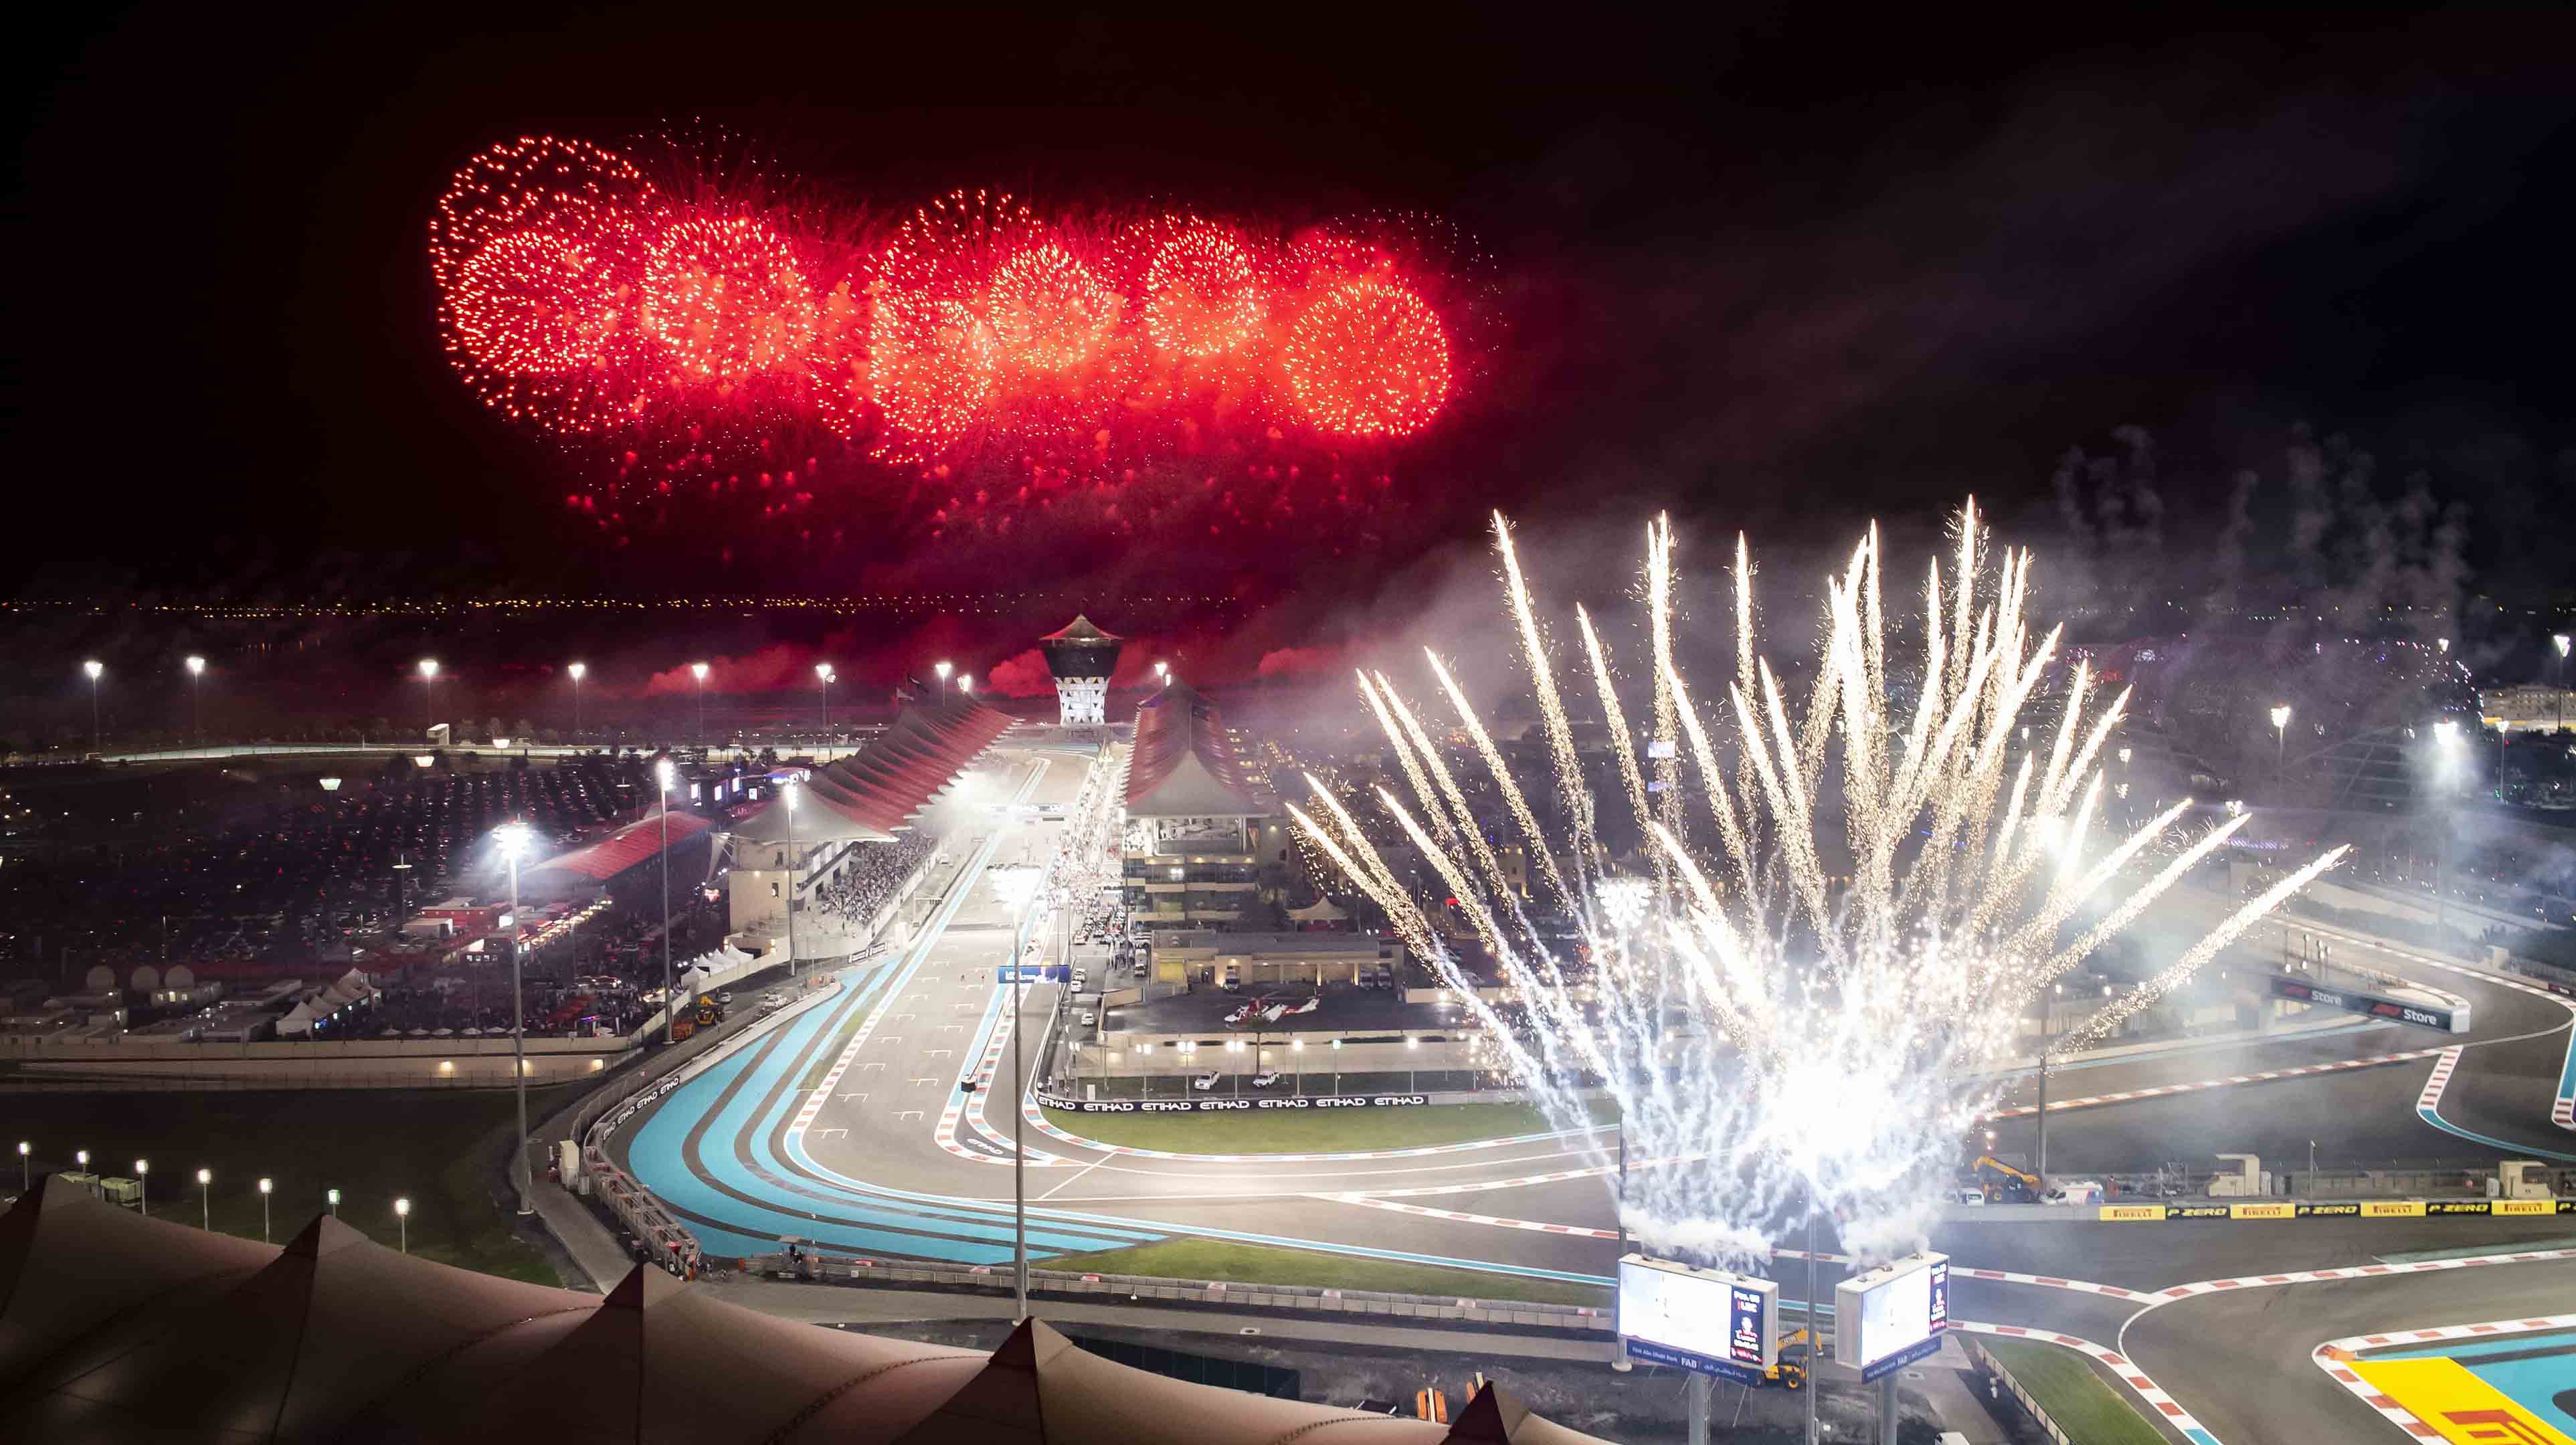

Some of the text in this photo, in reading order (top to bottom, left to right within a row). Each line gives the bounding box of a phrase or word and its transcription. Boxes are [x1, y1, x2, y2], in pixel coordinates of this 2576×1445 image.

[2312, 990, 2342, 1005] Store
[2403, 1009, 2437, 1025] Store
[659, 1078, 679, 1094] ETIHAD
[636, 1091, 658, 1109] ETIHAD
[1039, 1096, 1075, 1110] ETIHAD
[1259, 1099, 1308, 1108] ETIHAD
[1316, 1098, 1366, 1107] ETIHAD
[1374, 1096, 1424, 1105] ETIHAD
[1084, 1103, 1133, 1111] ETIHAD
[1141, 1102, 1192, 1111] ETIHAD
[1200, 1101, 1250, 1110] ETIHAD
[618, 1106, 635, 1124] ETIHAD
[967, 1139, 1003, 1155] ETIHAD
[2298, 1206, 2357, 1215] P ZERO
[2373, 1205, 2412, 1214] PIRELLI
[2429, 1203, 2488, 1212] P ZERO
[2504, 1203, 2543, 1212] PIRELLI
[2559, 1203, 2571, 1211] P
[2167, 1208, 2227, 1217] P ZERO
[1681, 1357, 1697, 1369] FAB
[1898, 1355, 1908, 1366] FAB
